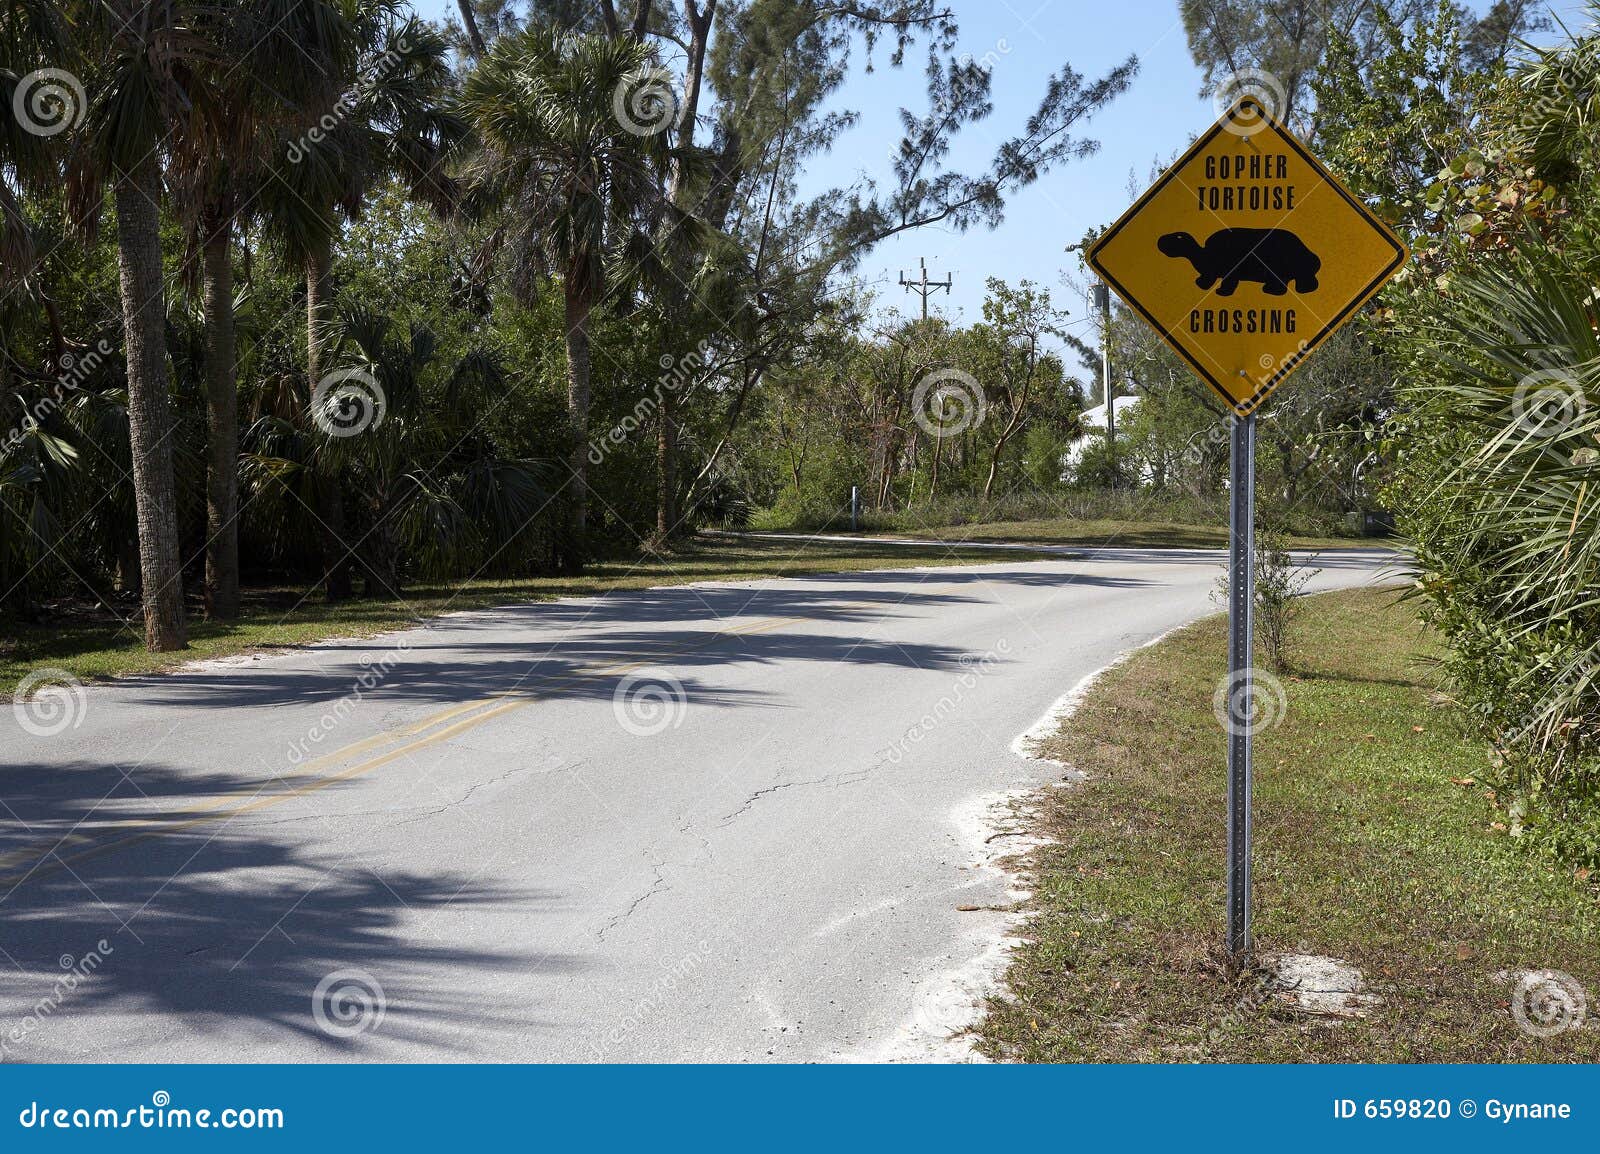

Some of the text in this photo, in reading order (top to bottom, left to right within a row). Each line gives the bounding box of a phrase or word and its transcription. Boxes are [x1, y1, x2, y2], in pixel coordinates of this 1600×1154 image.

[1205, 154, 1288, 180] GOPHER
[1197, 185, 1295, 211] TORTOISE
[1189, 308, 1297, 334] CROSSING
